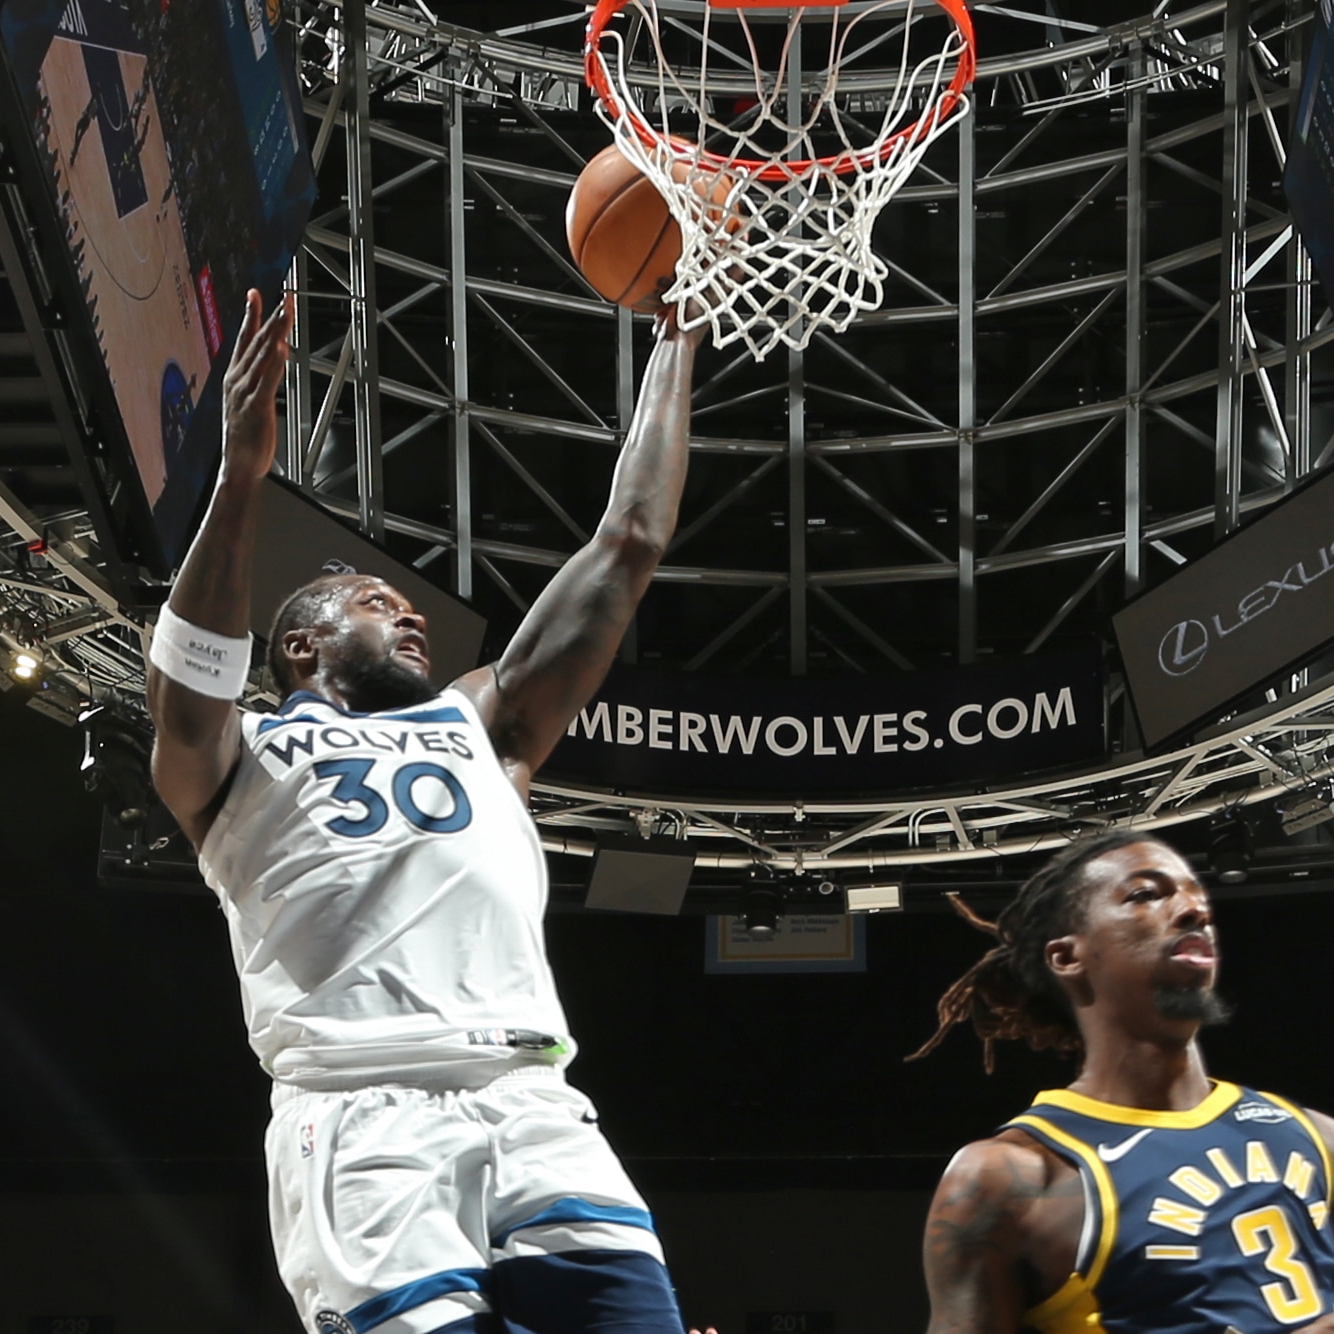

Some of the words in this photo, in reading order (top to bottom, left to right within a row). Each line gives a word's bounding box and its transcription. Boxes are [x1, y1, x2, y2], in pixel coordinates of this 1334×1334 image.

[265, 728, 474, 767] WOLVES
[568, 687, 1076, 756] MBERWOLVES.COM
[313, 758, 473, 838] 30
[1145, 1141, 1329, 1260] INDIANA
[1232, 1205, 1321, 1324] 3
